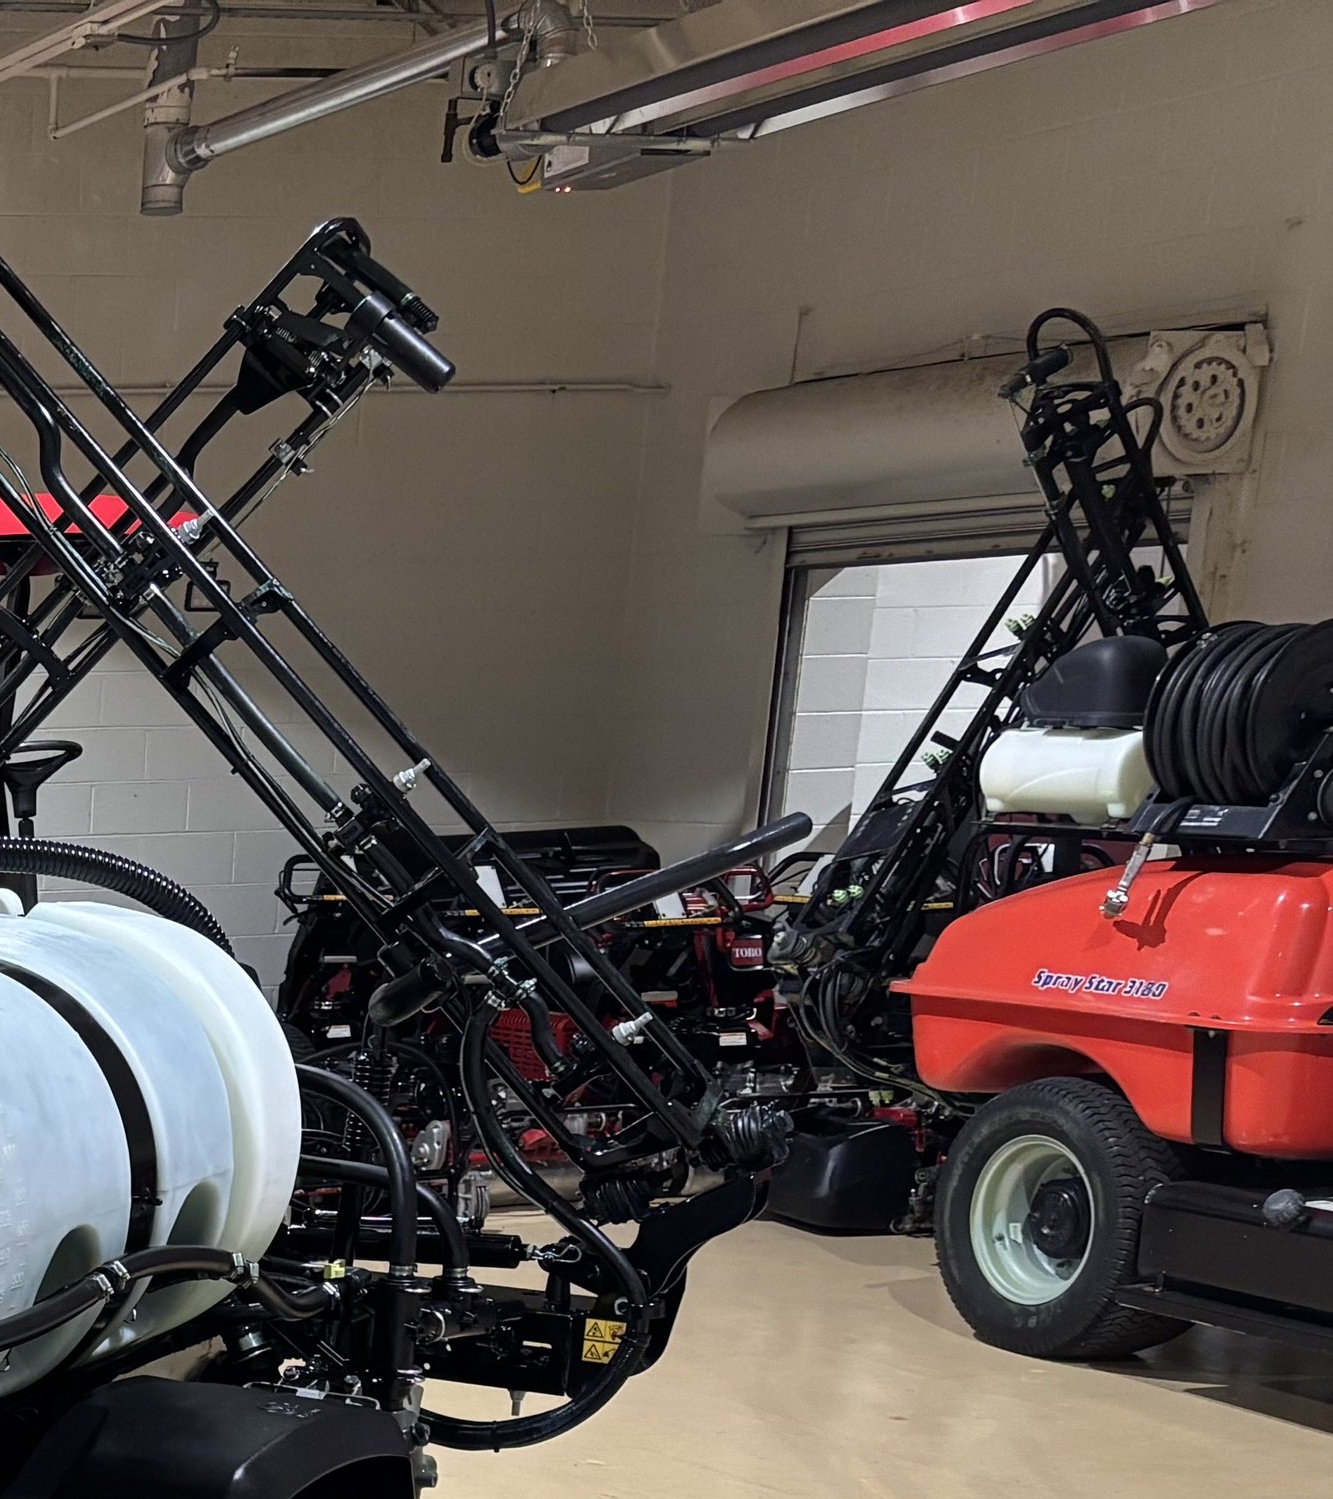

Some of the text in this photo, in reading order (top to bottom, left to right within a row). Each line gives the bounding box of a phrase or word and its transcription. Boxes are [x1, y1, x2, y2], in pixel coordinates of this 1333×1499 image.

[732, 947, 762, 958] TORO
[1032, 969, 1084, 992] Spray
[1084, 975, 1123, 994] Star
